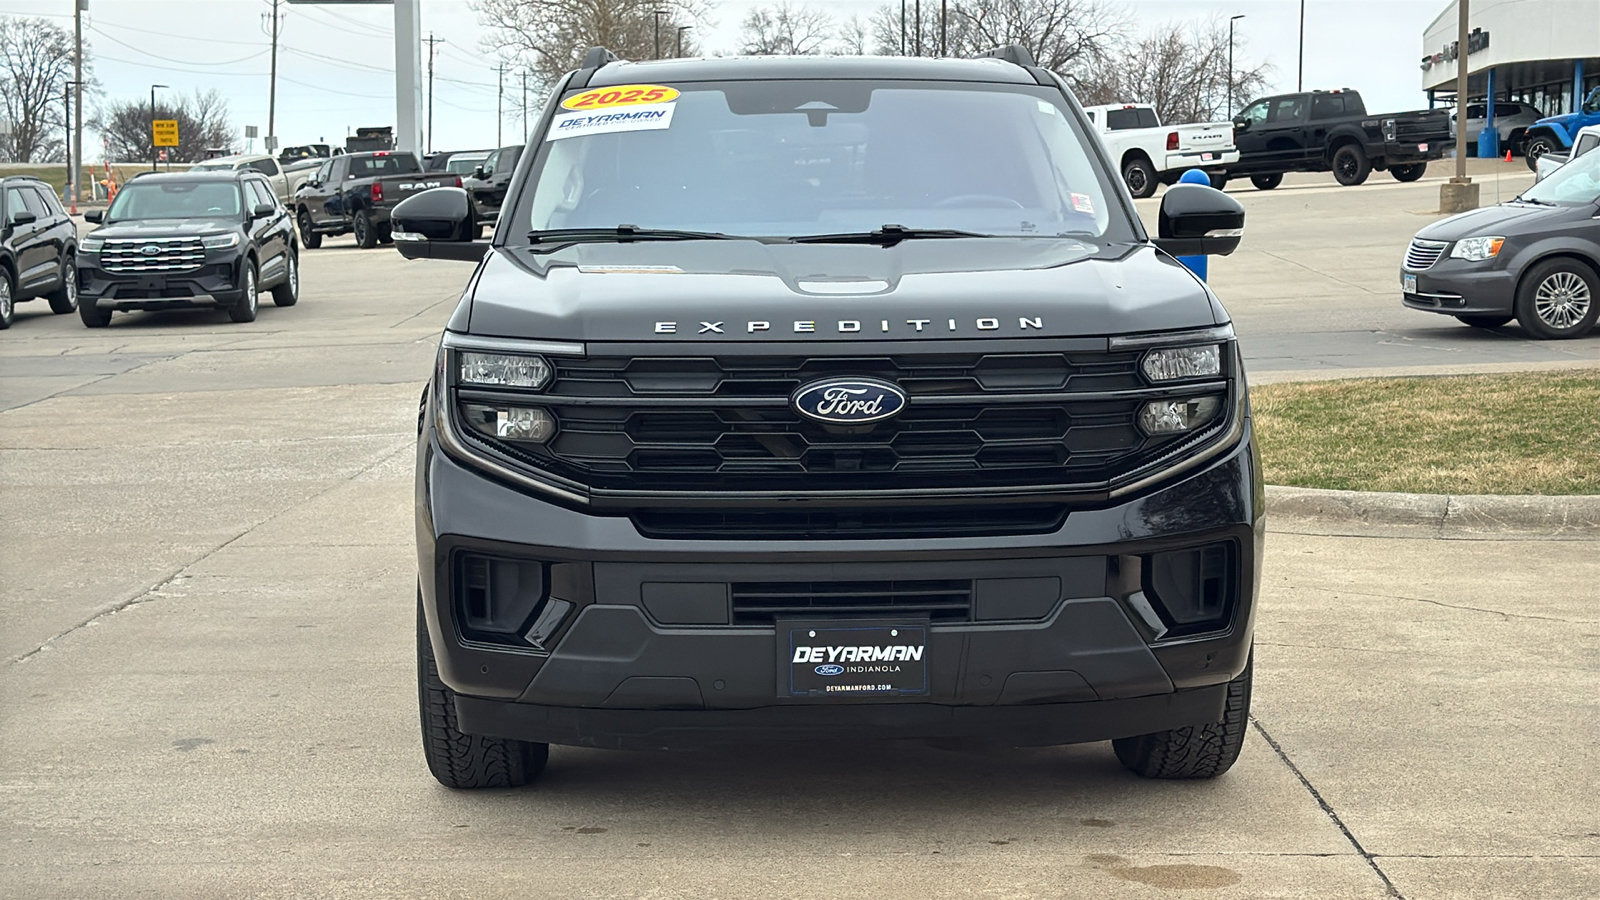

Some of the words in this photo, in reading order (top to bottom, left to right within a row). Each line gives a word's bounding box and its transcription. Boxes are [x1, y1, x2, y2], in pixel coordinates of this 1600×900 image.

[572, 89, 669, 108] 2025
[558, 110, 667, 129] DEYARMAN
[564, 121, 609, 131] CERTIFIED
[399, 181, 440, 191] RAM
[654, 316, 1044, 334] EXPEDITION
[816, 387, 884, 415] Ford
[793, 645, 924, 663] DEYARMAN
[846, 665, 901, 673] INDIANOLA
[826, 684, 892, 692] DEYARMANFORD.COM
